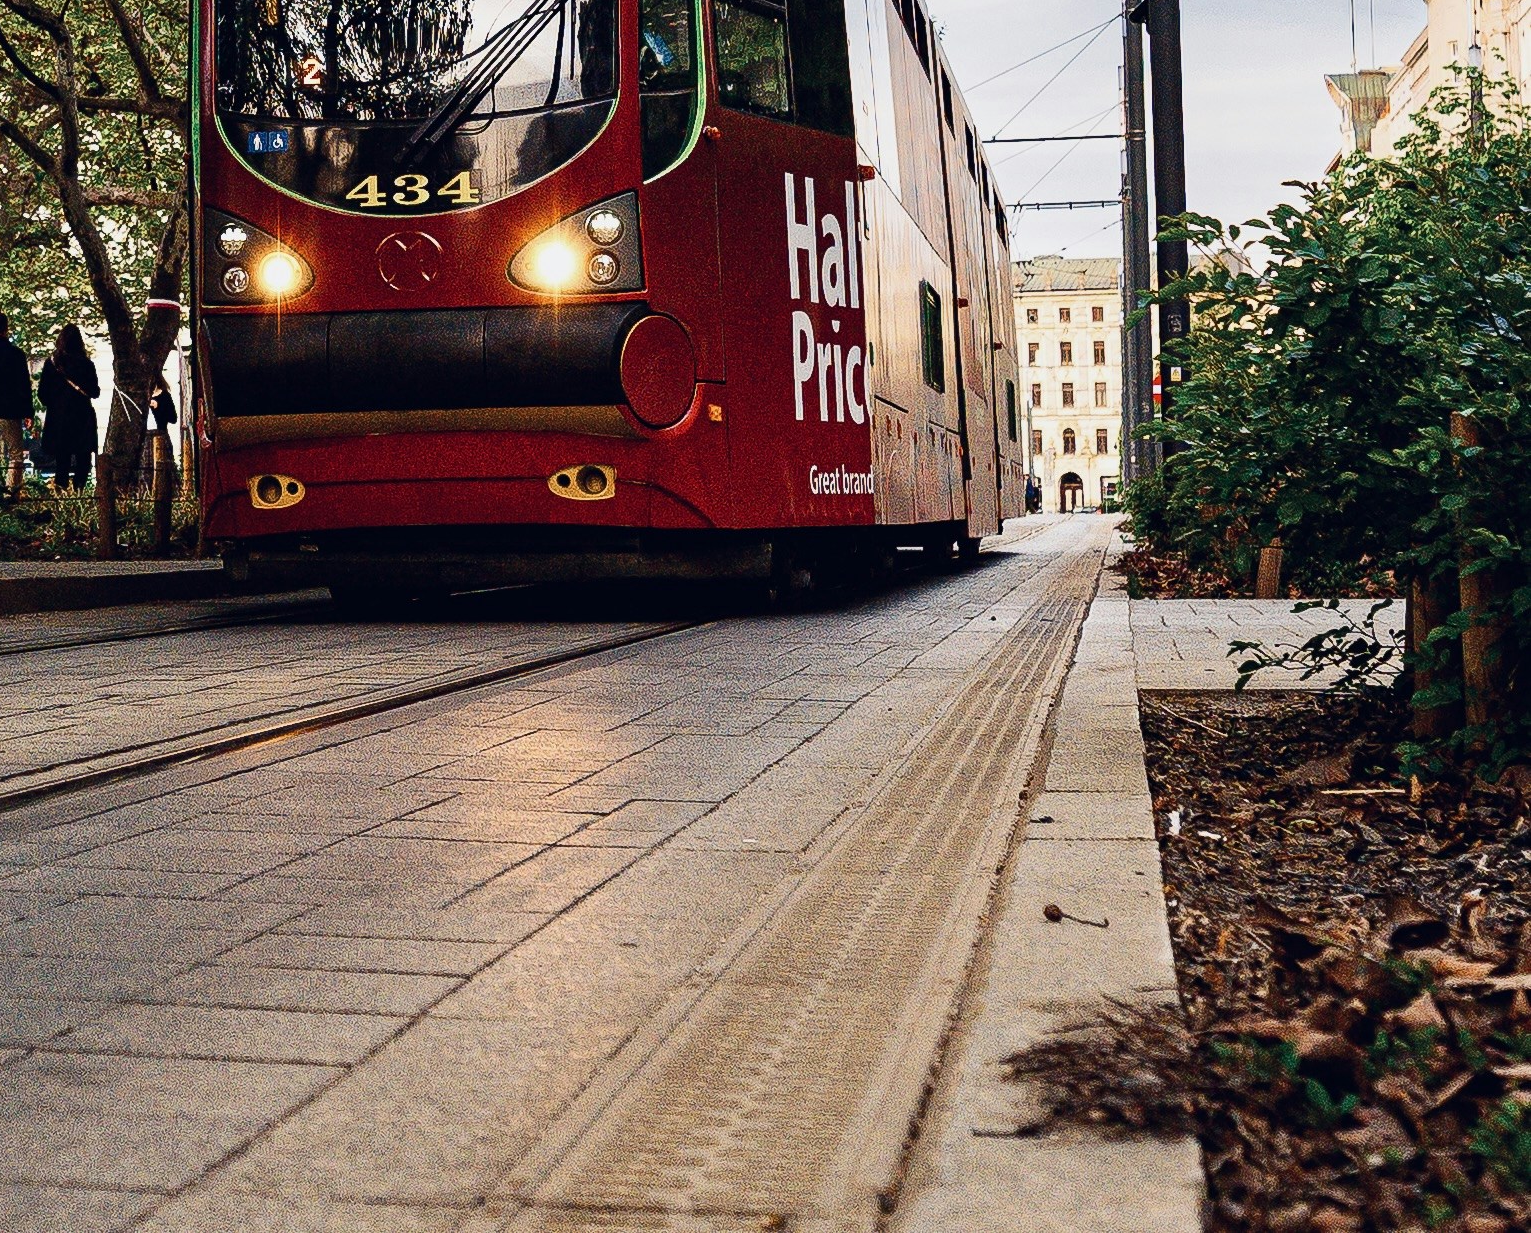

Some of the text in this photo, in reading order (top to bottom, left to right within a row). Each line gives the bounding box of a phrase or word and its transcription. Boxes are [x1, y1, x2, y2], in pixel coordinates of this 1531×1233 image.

[301, 57, 321, 85] 2
[345, 171, 480, 207] 434
[784, 171, 862, 309] Hal
[809, 463, 875, 495] Great brand
